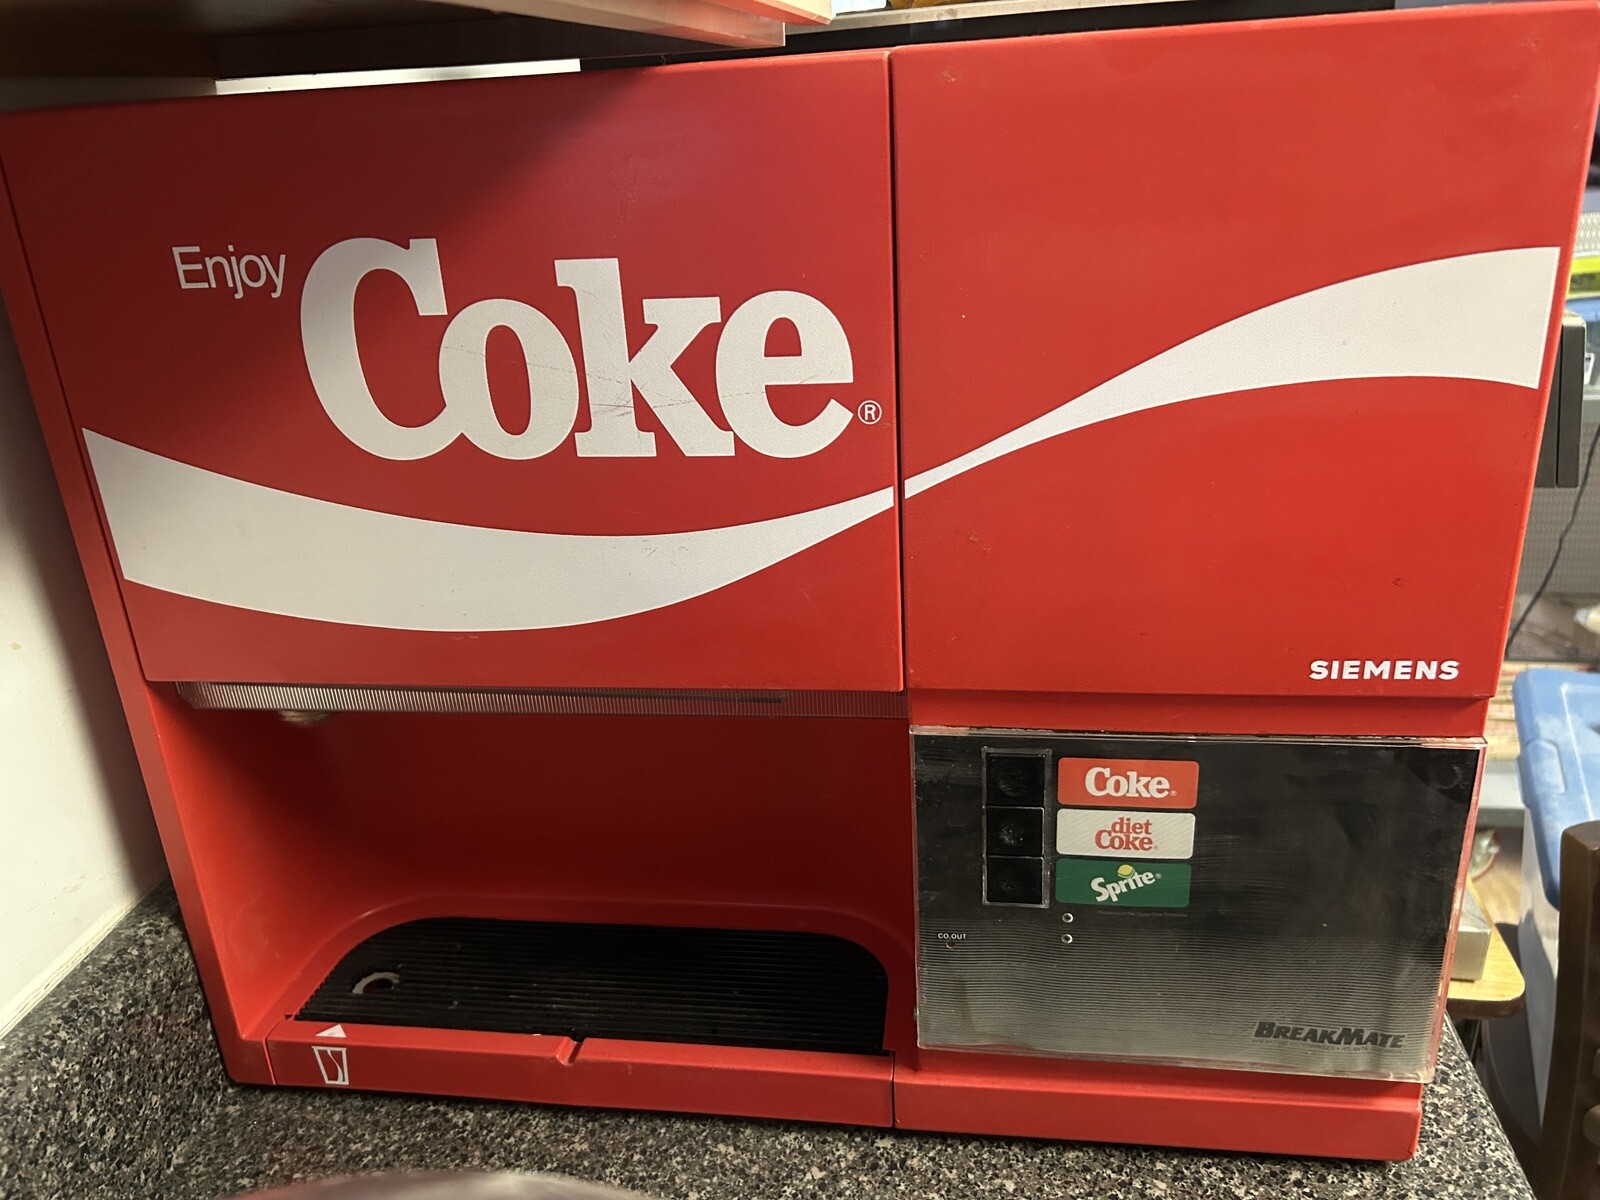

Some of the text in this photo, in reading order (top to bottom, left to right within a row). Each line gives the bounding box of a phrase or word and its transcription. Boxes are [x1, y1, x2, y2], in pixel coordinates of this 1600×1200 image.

[171, 244, 286, 299] Enjoy
[1309, 659, 1460, 680] SIEMENS
[1111, 817, 1152, 835] diet
